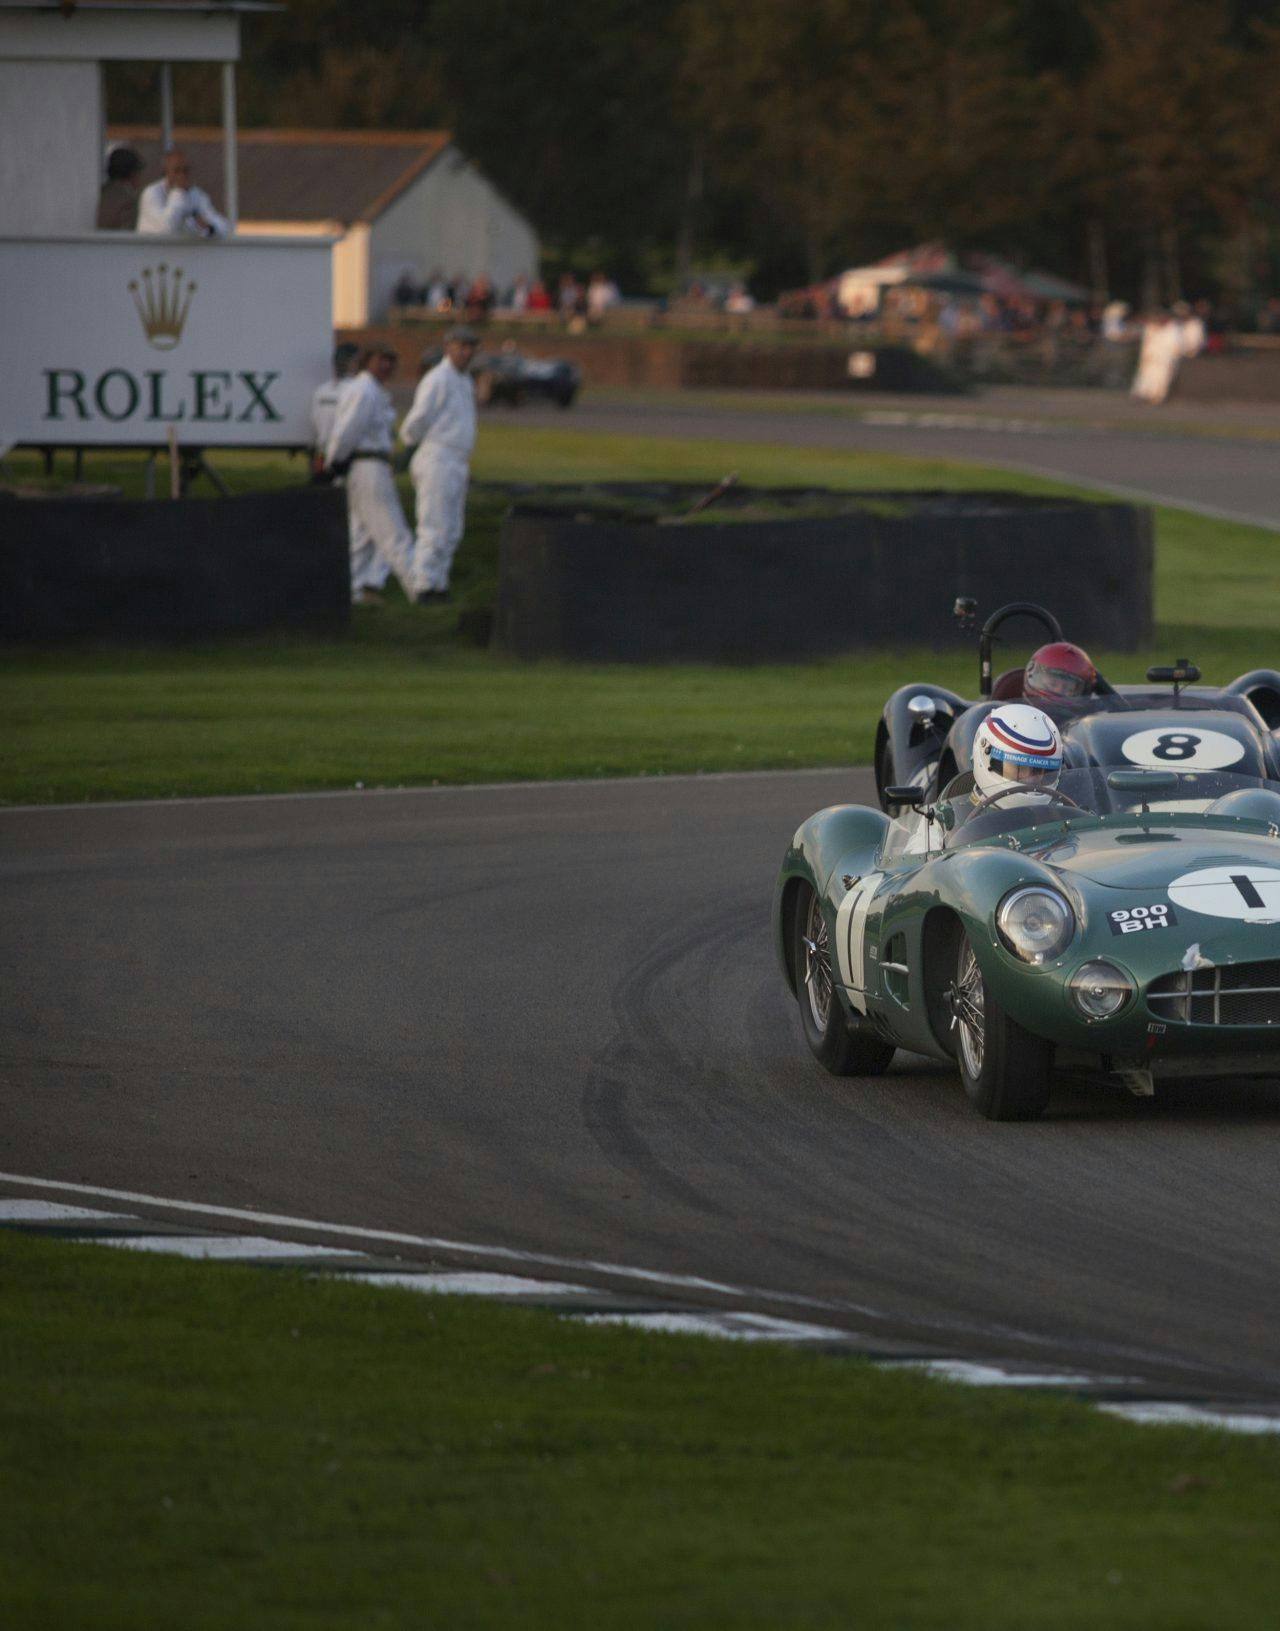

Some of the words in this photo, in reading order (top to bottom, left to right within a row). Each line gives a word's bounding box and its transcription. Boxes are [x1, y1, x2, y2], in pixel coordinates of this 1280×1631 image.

[43, 368, 284, 422] ROLEX
[1152, 733, 1201, 760] 8
[1229, 875, 1266, 908] 1
[1111, 904, 1168, 922] 900
[1120, 915, 1168, 934] BH
